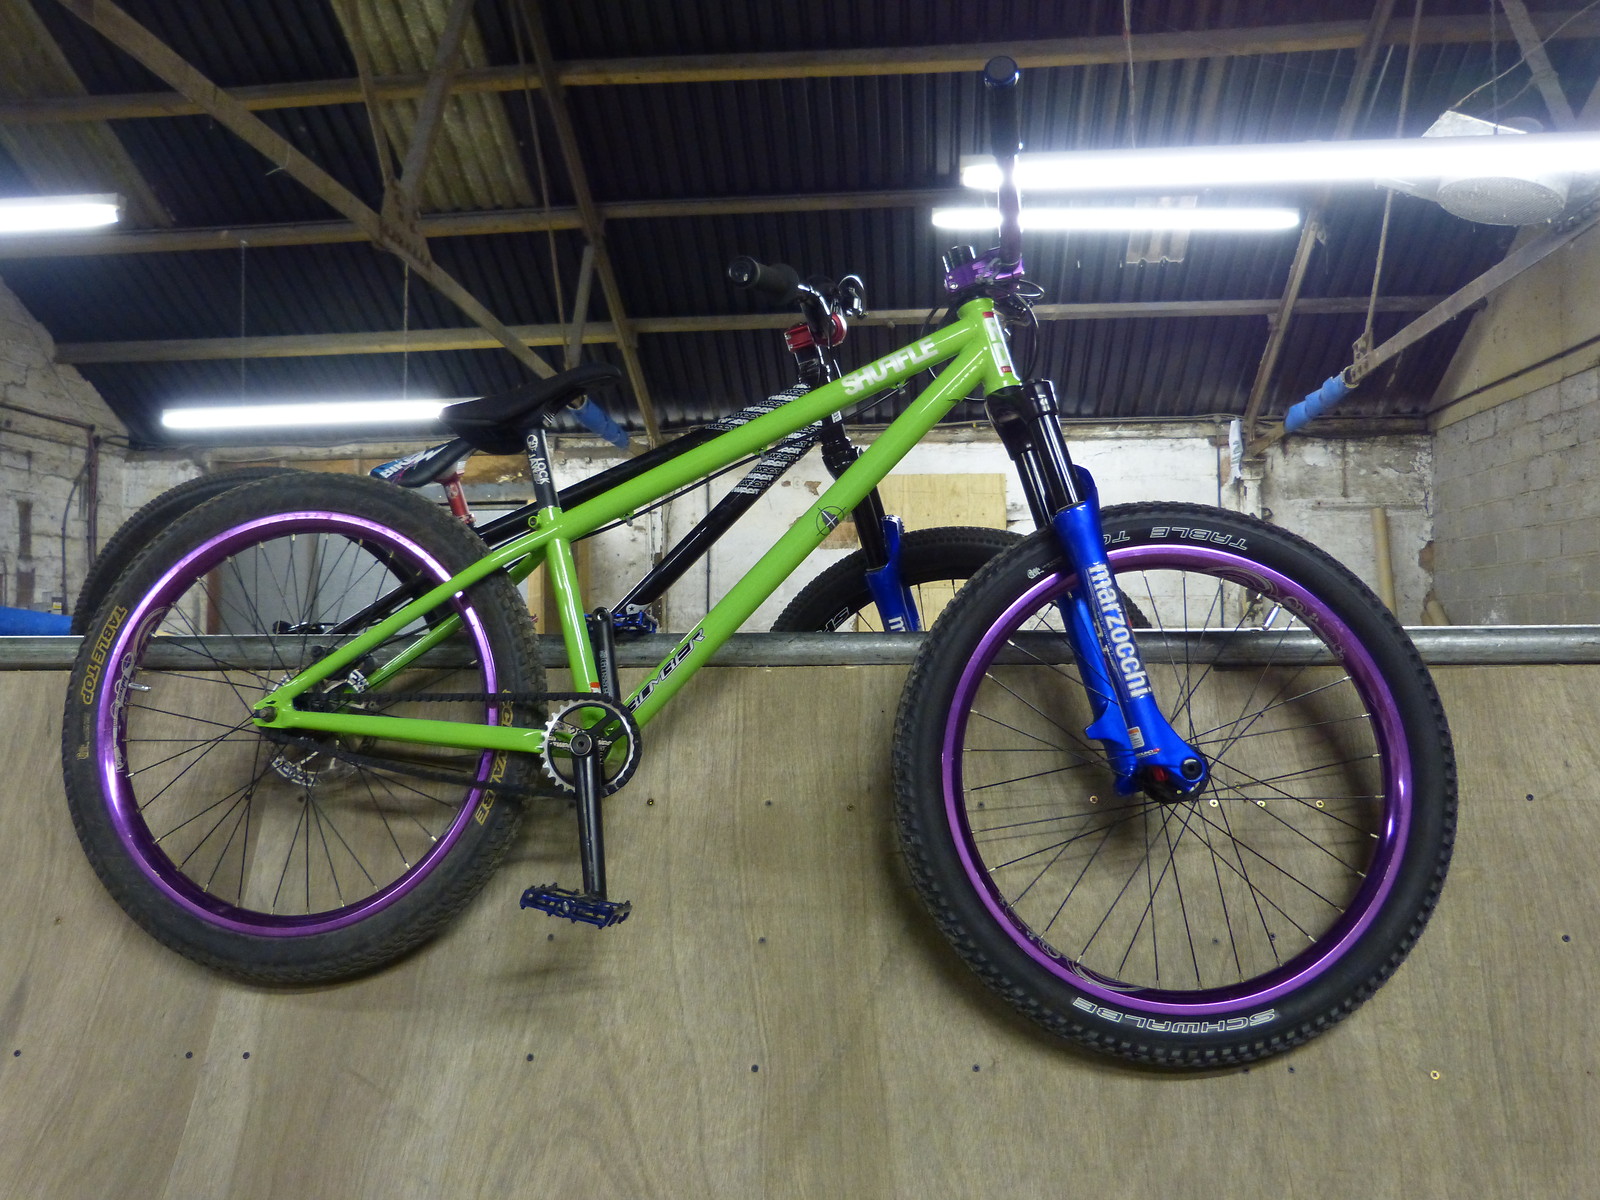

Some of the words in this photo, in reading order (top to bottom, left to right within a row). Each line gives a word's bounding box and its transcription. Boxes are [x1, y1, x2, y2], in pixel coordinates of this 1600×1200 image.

[1103, 530, 1131, 546] TO
[1150, 526, 1248, 550] TABLE
[91, 605, 128, 664] TABLE
[1088, 563, 1152, 698] marzocchi
[81, 664, 101, 705] TOP
[1072, 997, 1275, 1034] SCHWALBE
